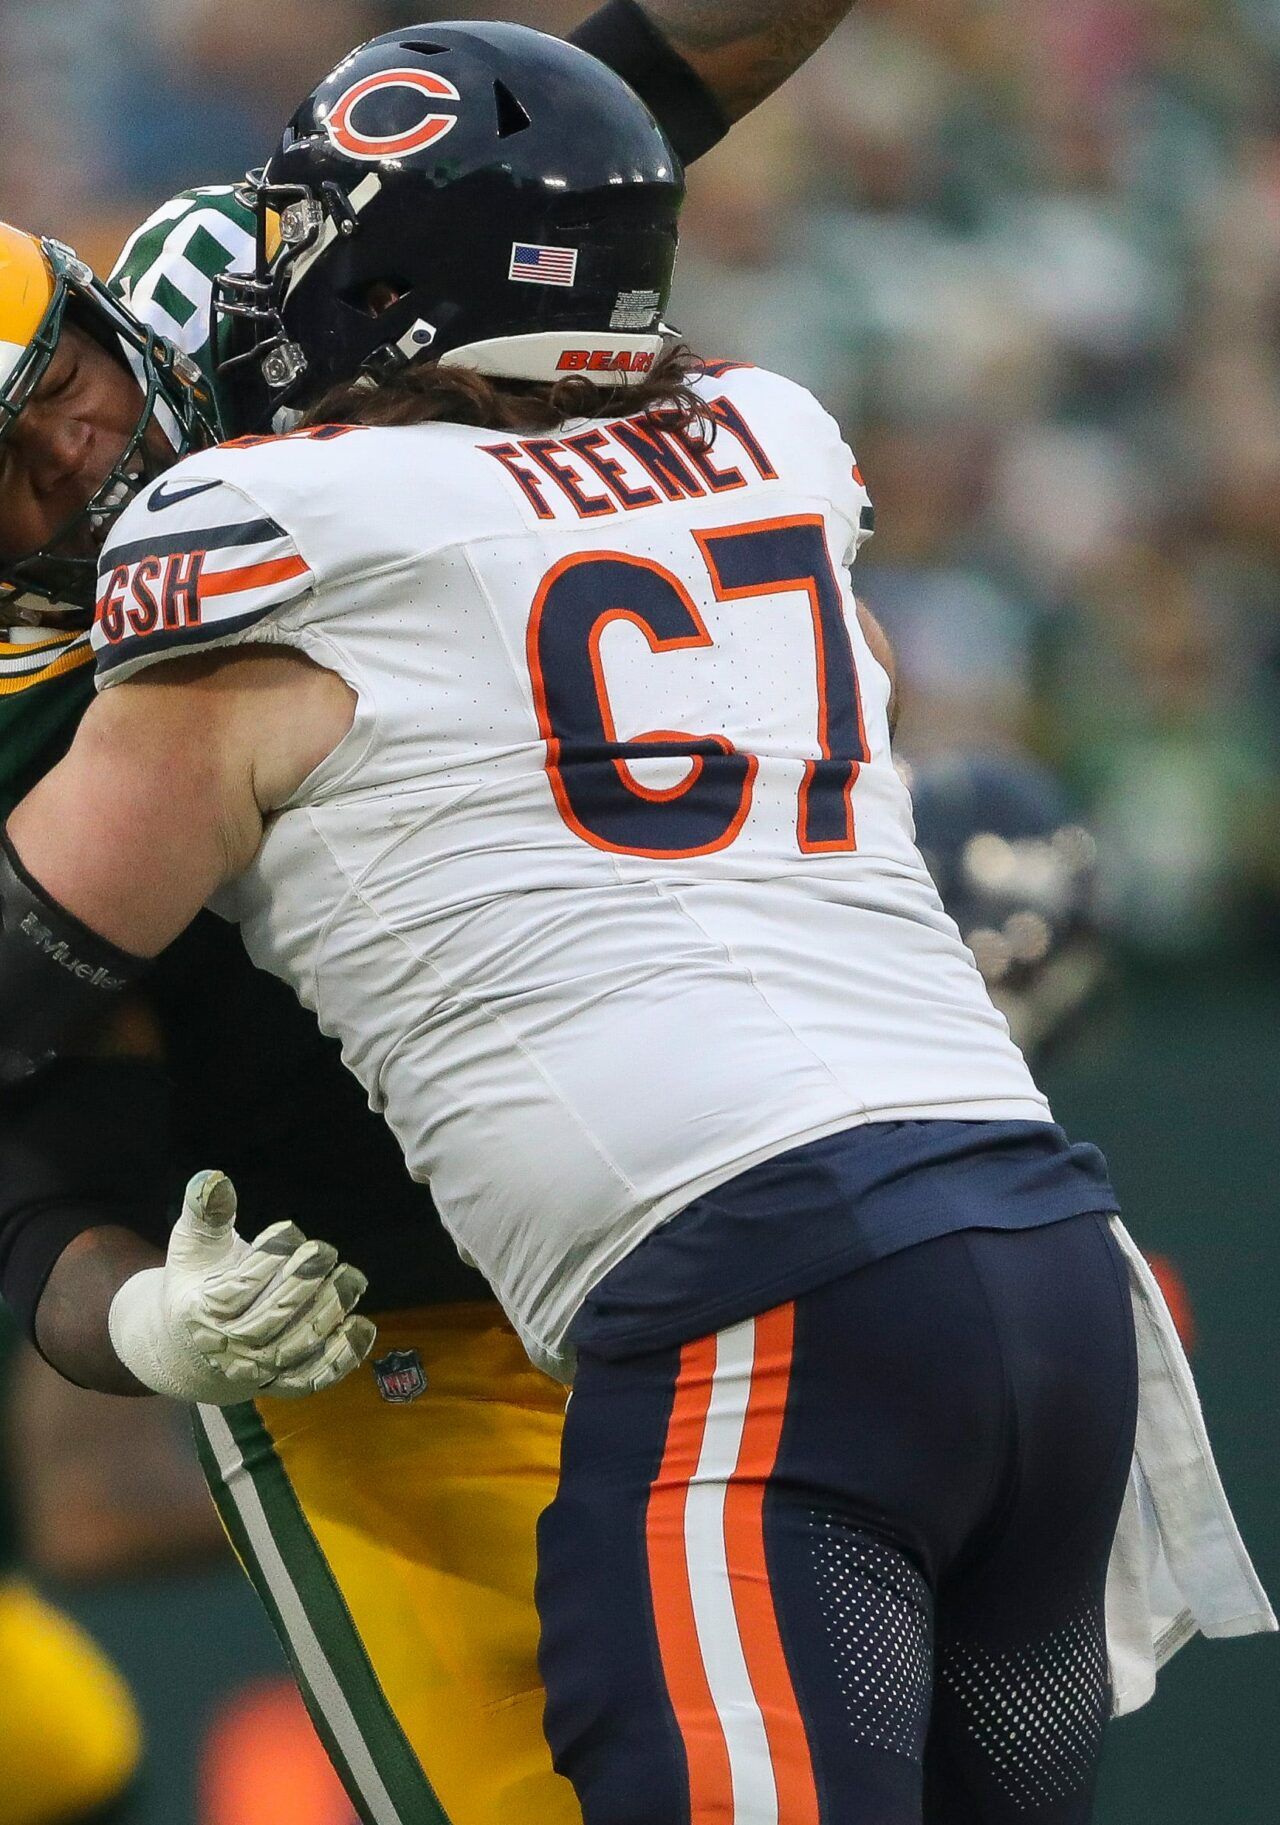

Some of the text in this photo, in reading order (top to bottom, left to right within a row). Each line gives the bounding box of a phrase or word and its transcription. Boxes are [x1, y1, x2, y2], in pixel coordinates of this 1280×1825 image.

[475, 395, 780, 520] FEENEY
[100, 549, 206, 645] GSH
[525, 513, 872, 860] 67
